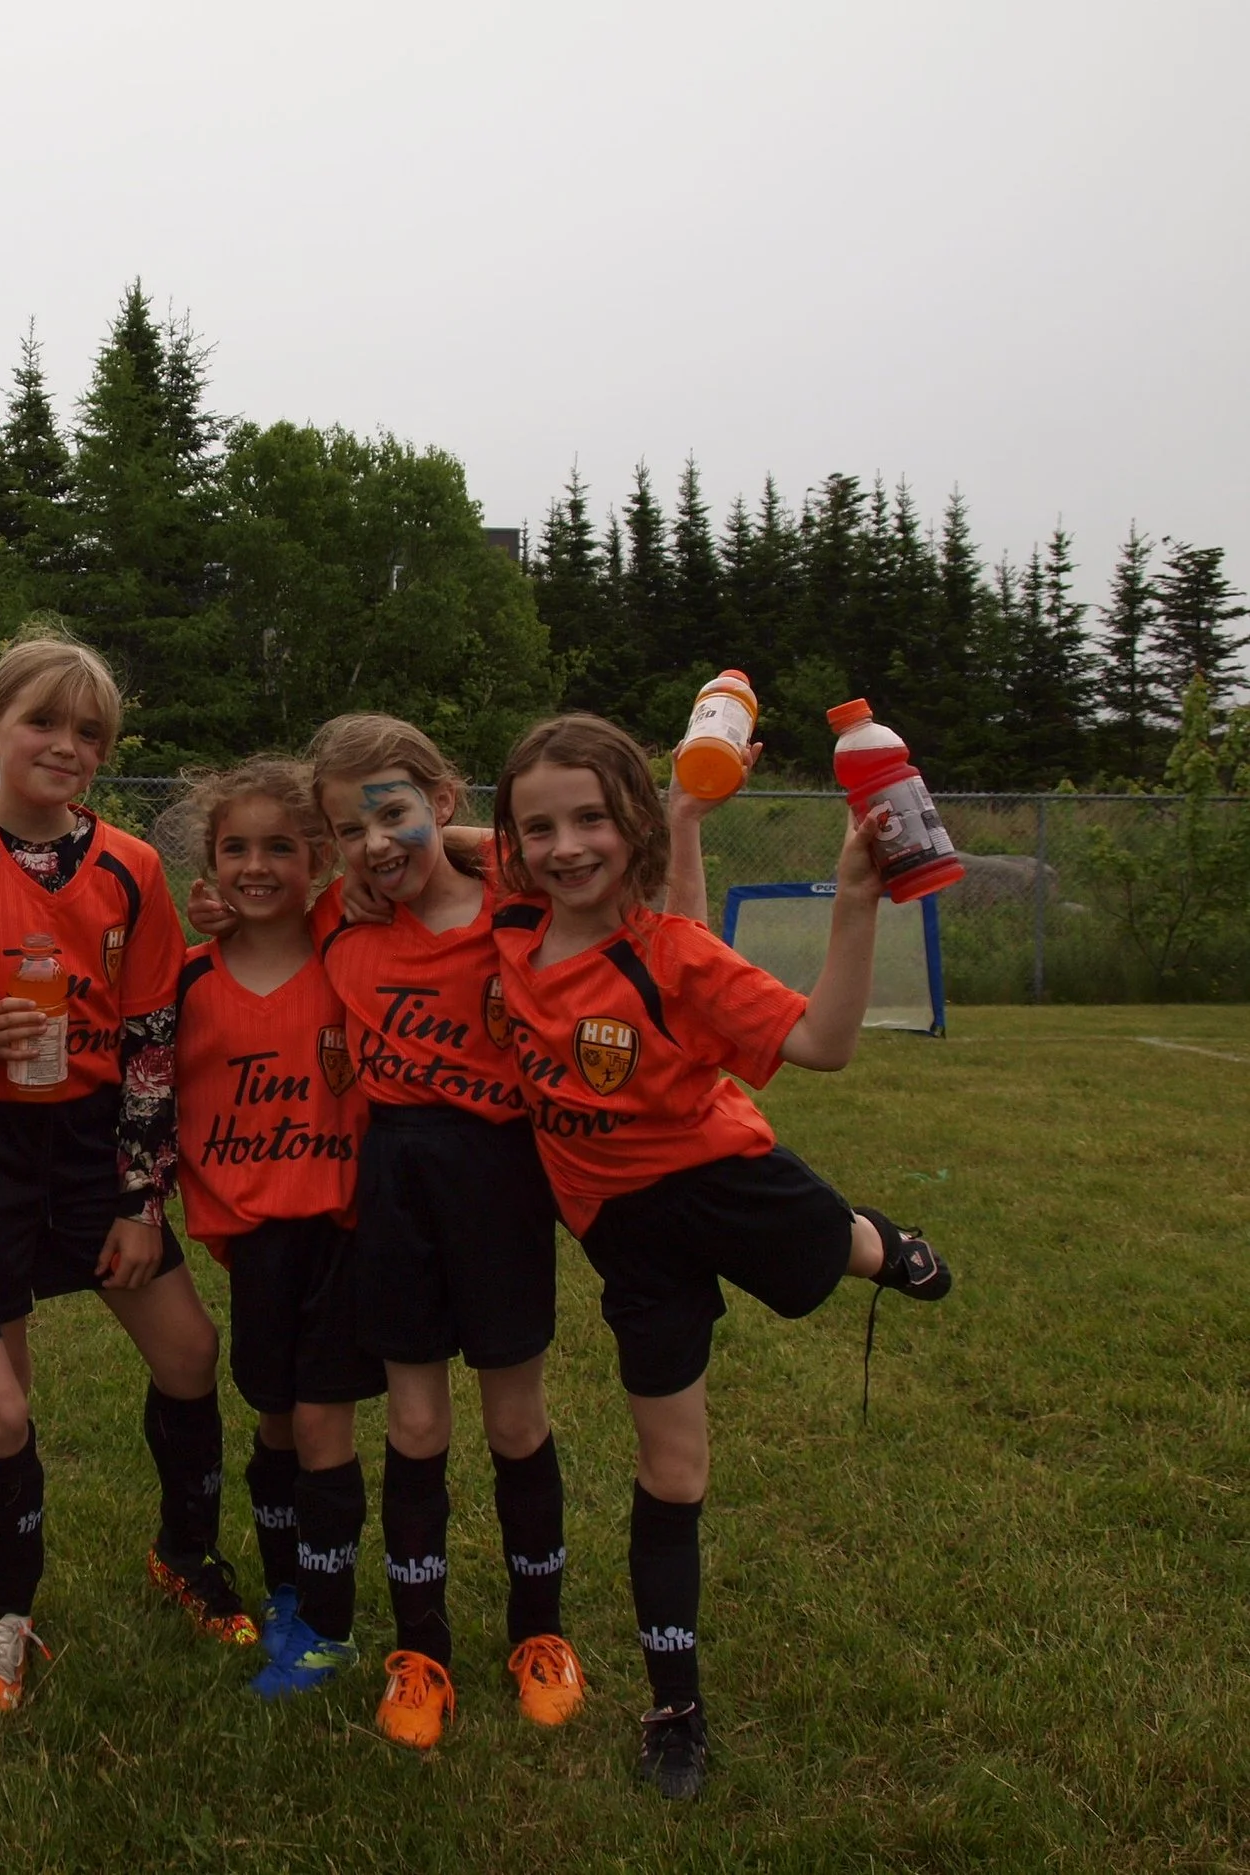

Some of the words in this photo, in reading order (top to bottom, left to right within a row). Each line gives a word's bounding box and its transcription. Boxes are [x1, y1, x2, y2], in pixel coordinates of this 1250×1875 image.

[376, 986, 470, 1049] Tim
[584, 1022, 632, 1048] HCU
[325, 1030, 347, 1049] HC
[227, 1051, 311, 1106] Tim
[201, 1114, 353, 1167] Hortons
[297, 1540, 359, 1574] timbits
